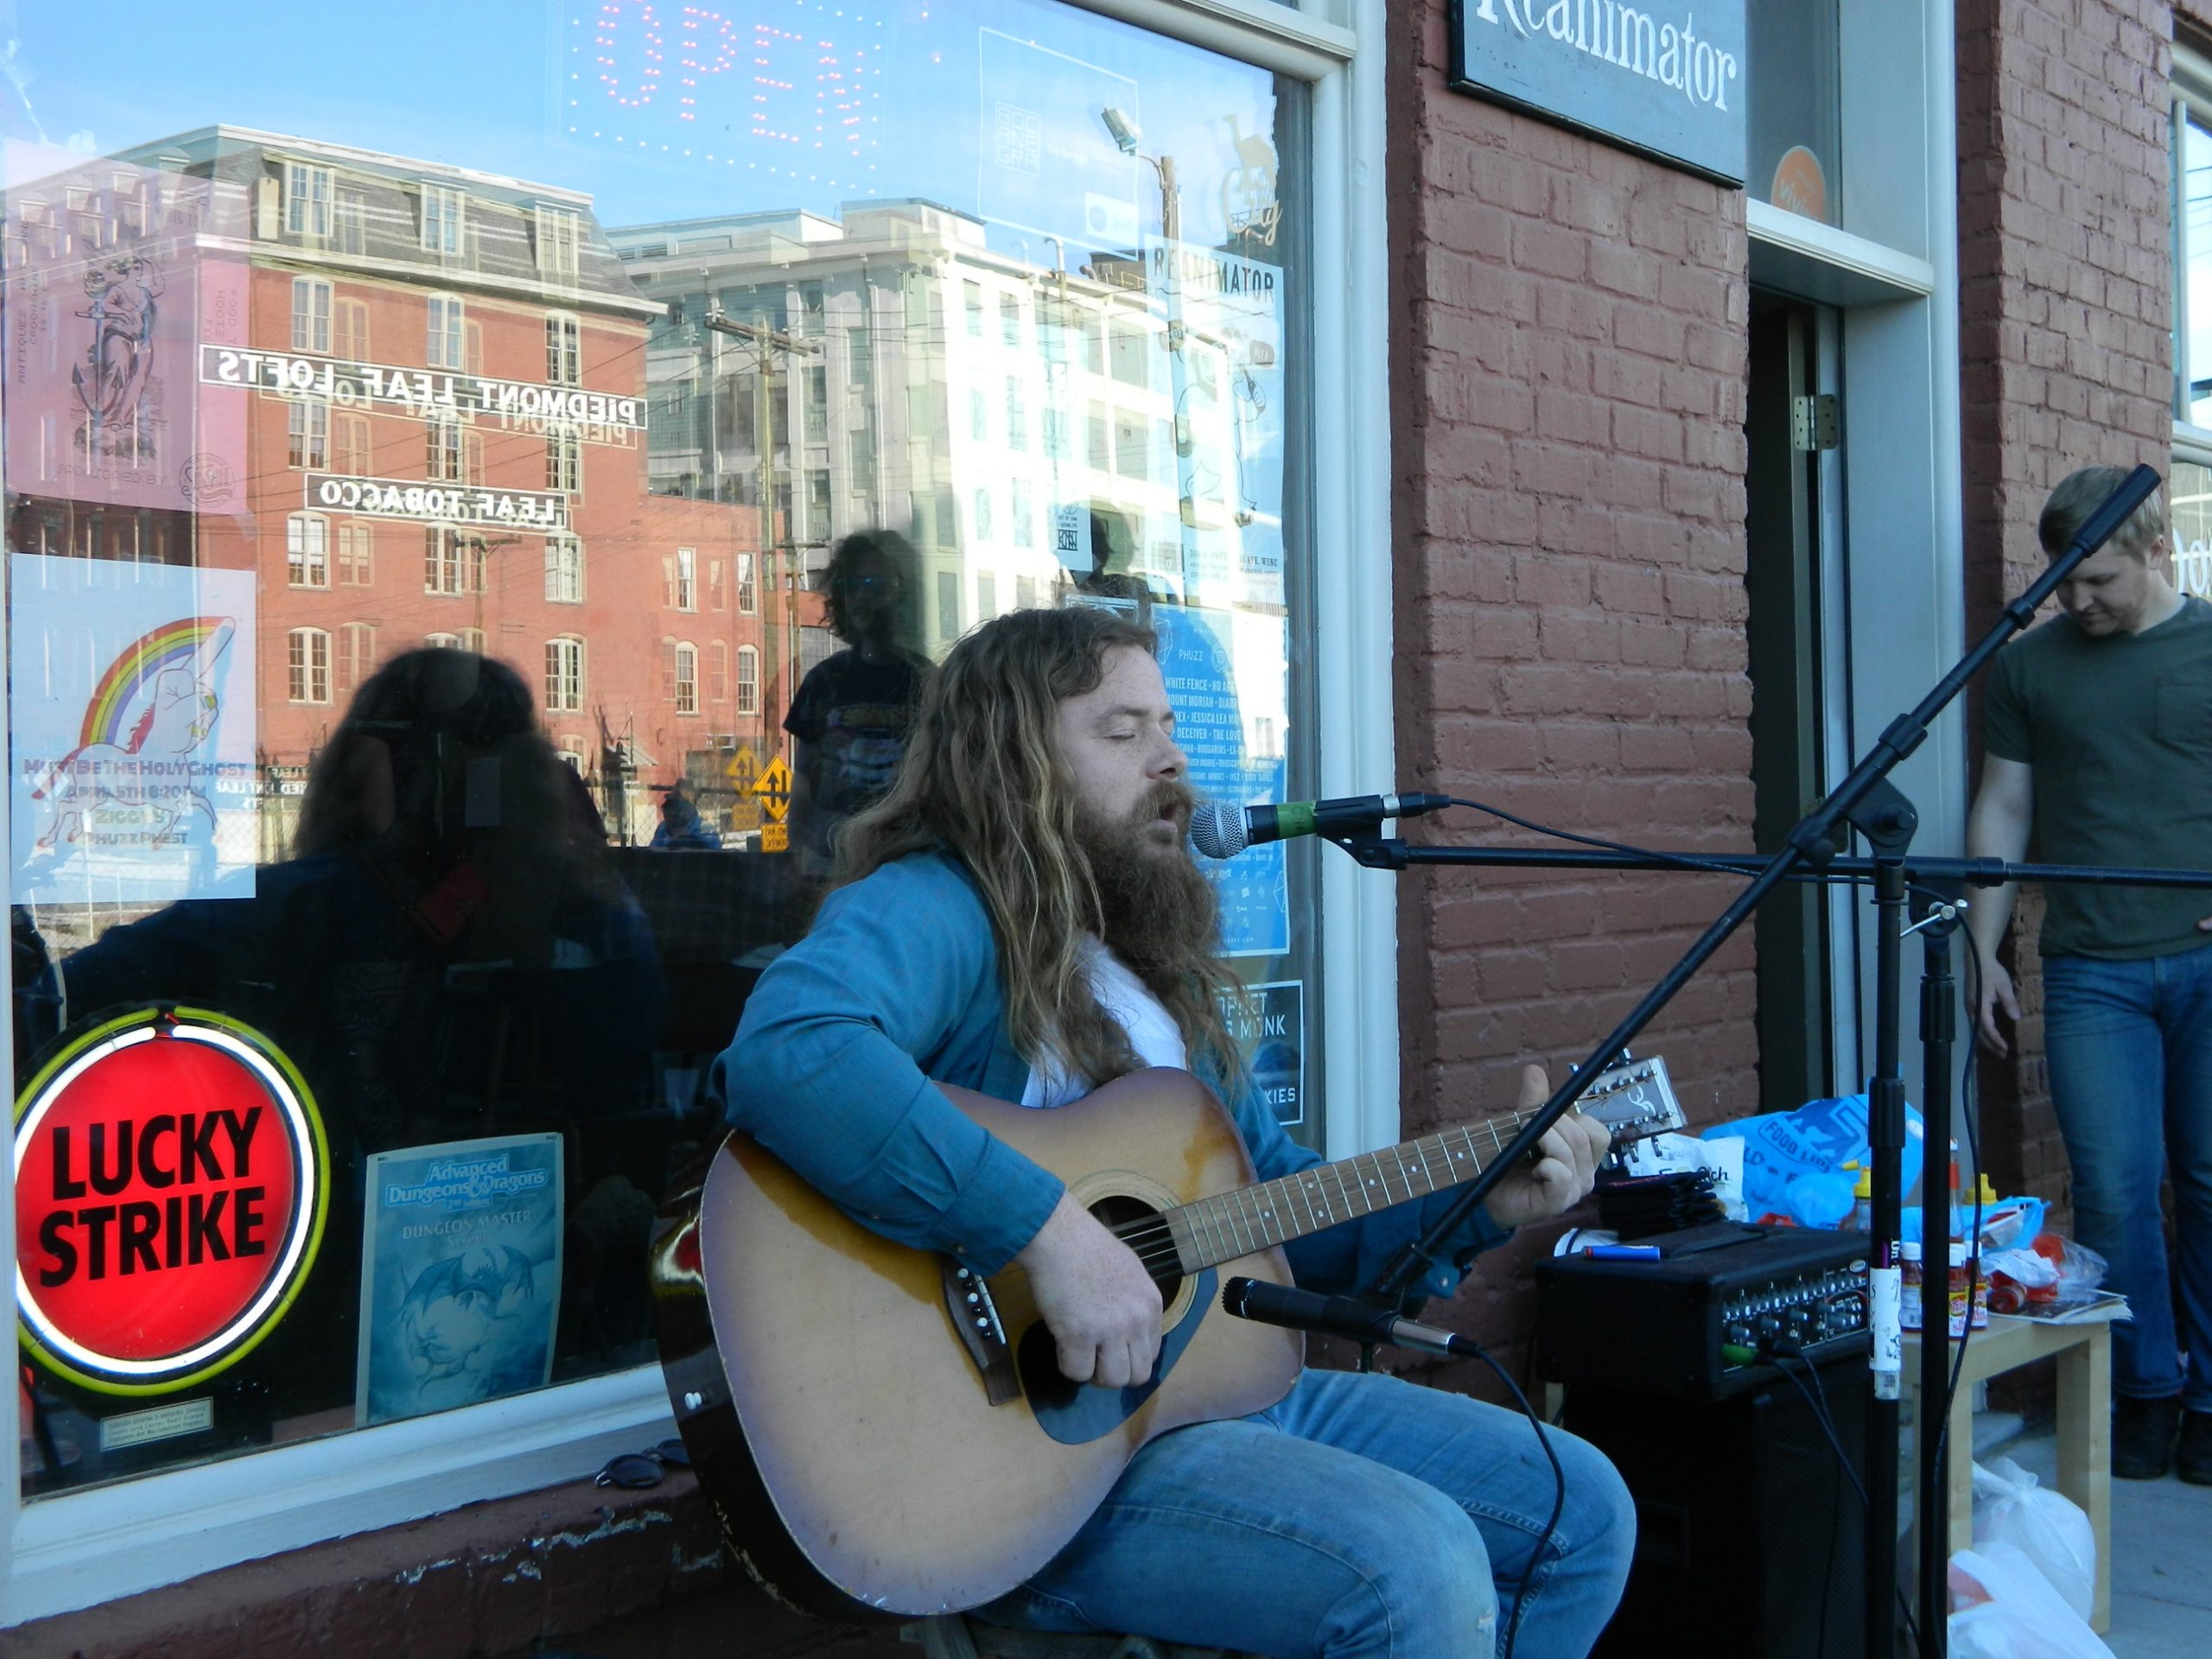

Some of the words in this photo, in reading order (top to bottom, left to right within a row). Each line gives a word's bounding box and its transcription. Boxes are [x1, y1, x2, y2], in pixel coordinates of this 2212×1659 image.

[594, 0, 865, 157] OPEN
[1154, 248, 1274, 304] REANIMATOR
[17, 309, 29, 385] ANTIQUES
[1179, 649, 1203, 662] PHUZZ
[1165, 677, 1185, 690] WHITE
[1186, 677, 1208, 691] FENCE
[1188, 695, 1214, 709] MORIAH
[1190, 711, 1215, 724] JESSICA
[1216, 714, 1227, 725] LEA
[1177, 727, 1207, 740] DECEIVER
[1213, 728, 1224, 741] THE
[188, 760, 248, 777] GHOST
[1764, 1120, 1799, 1155] FOOD
[51, 1106, 263, 1200] LUCKY
[429, 1155, 508, 1182] Advanced
[388, 1180, 469, 1205] Dungeons
[484, 1170, 546, 1195] Dragons
[39, 1185, 266, 1287] STRIKE
[402, 1217, 474, 1240] DUNGEON
[477, 1210, 531, 1229] MASTER
